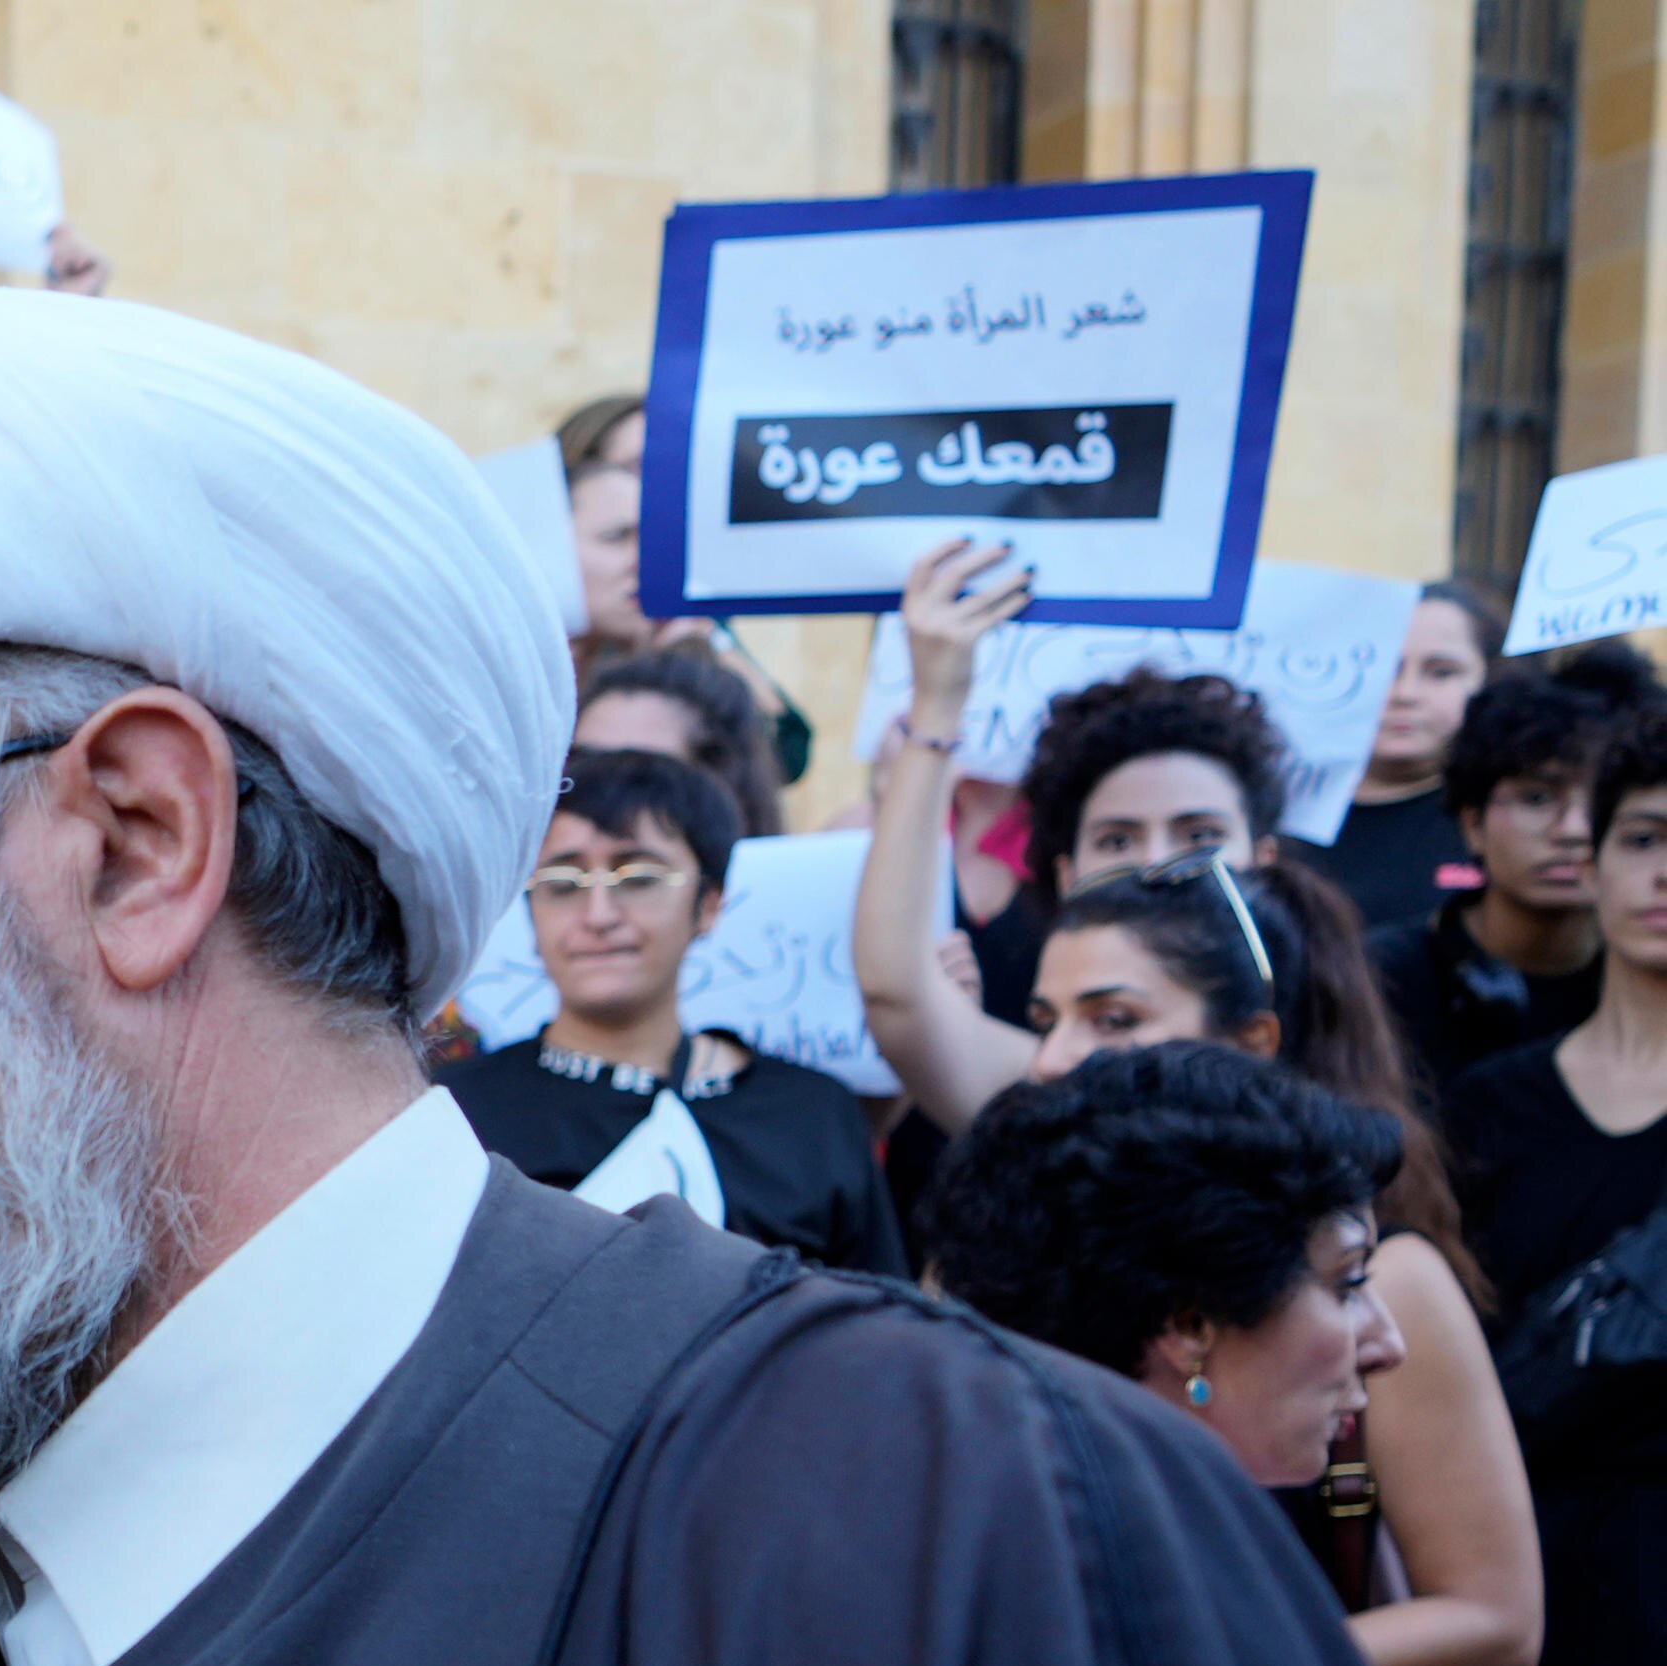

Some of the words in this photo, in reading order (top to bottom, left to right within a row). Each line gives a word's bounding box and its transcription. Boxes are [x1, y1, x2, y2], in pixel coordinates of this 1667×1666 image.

[777, 306, 857, 352] عورة
[874, 307, 934, 350] منو
[948, 284, 1047, 344] المرأة
[1062, 289, 1147, 342] شعر
[757, 423, 903, 504] عورة
[916, 410, 1115, 487] قمعك
